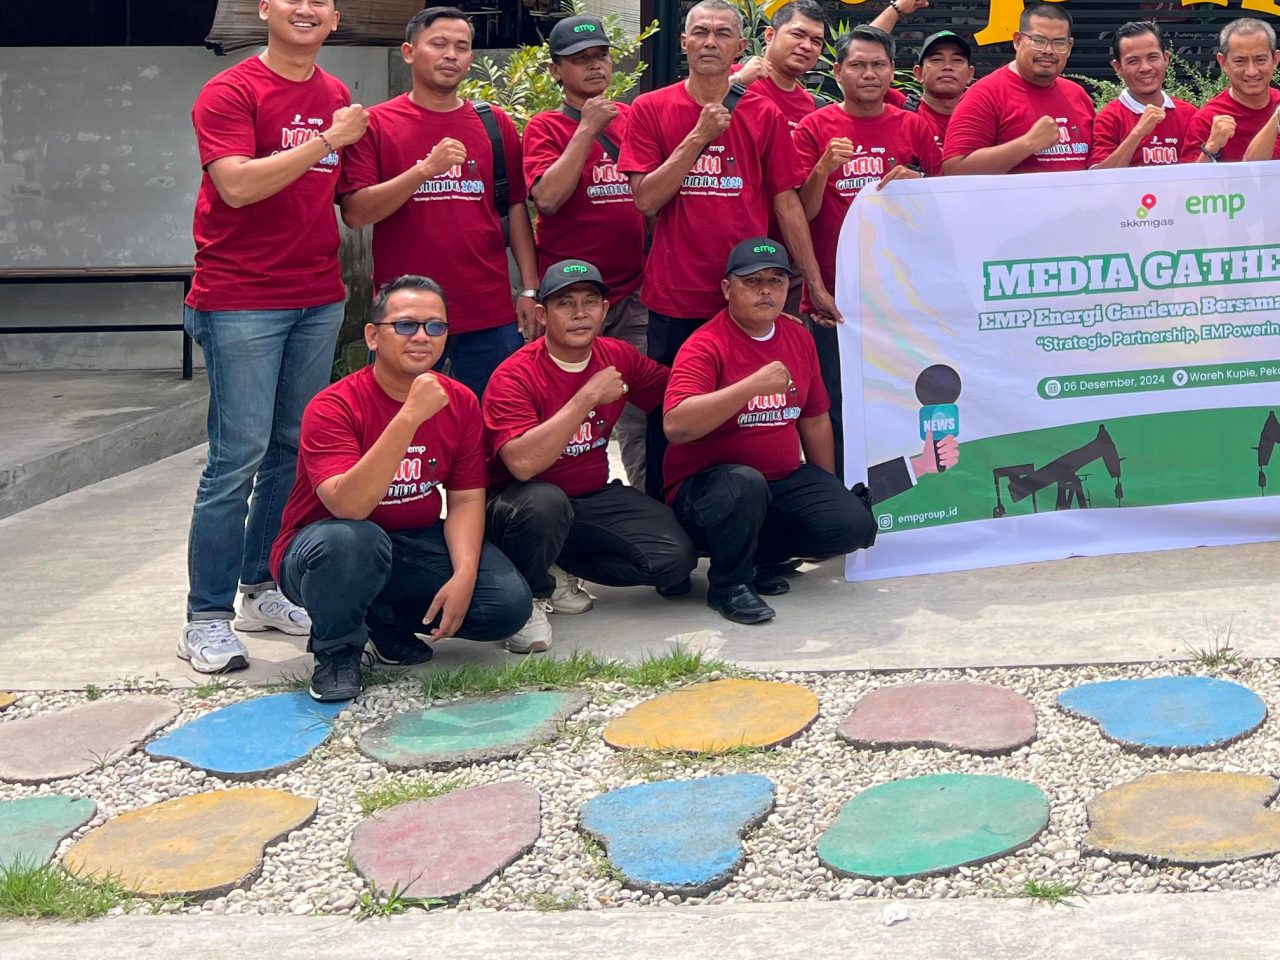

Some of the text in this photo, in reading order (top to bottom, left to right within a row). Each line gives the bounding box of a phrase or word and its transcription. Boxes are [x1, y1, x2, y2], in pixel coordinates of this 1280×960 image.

[573, 22, 597, 33] emp
[1185, 192, 1246, 220] emp
[1120, 217, 1174, 228] skkmigas
[753, 244, 777, 254] emp
[563, 264, 588, 274] emp
[985, 255, 1137, 299] MEDIA
[980, 311, 1031, 330] EMP
[1035, 306, 1102, 326] Energi
[1106, 301, 1198, 321] Gandewa
[1037, 335, 1110, 351] “Strategic
[1112, 327, 1199, 346] Partnership,
[1189, 369, 1224, 381] Wareh
[1226, 366, 1258, 380] Kupie,
[1063, 374, 1165, 391] 06 Desember, 2024
[923, 418, 956, 432] NEWS
[407, 445, 426, 455] emp
[898, 506, 958, 523] empgroup_id
